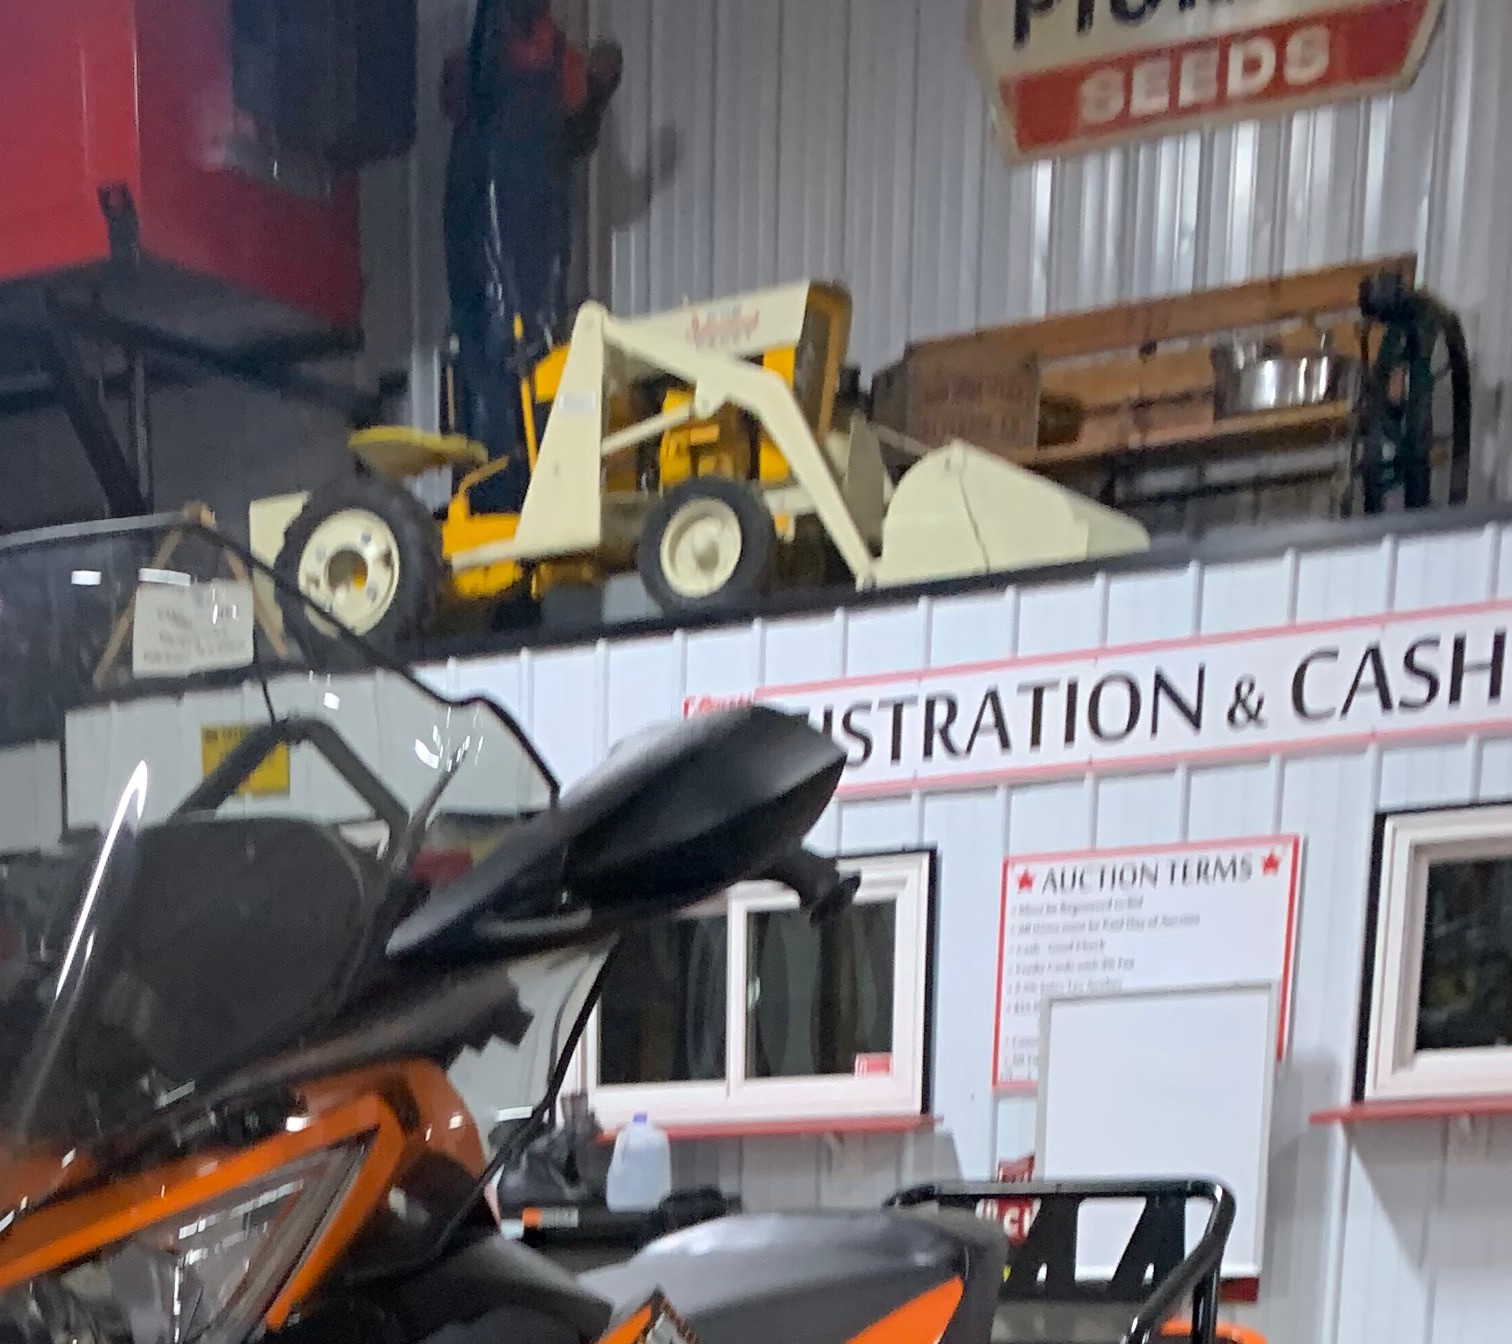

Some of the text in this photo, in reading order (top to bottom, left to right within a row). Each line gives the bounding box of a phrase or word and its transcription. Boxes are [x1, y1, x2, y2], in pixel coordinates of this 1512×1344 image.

[1080, 25, 1331, 124] SEEDS
[822, 625, 1506, 771] ISTRATION & CASH
[1041, 852, 1253, 895] AUCTION TERMS
